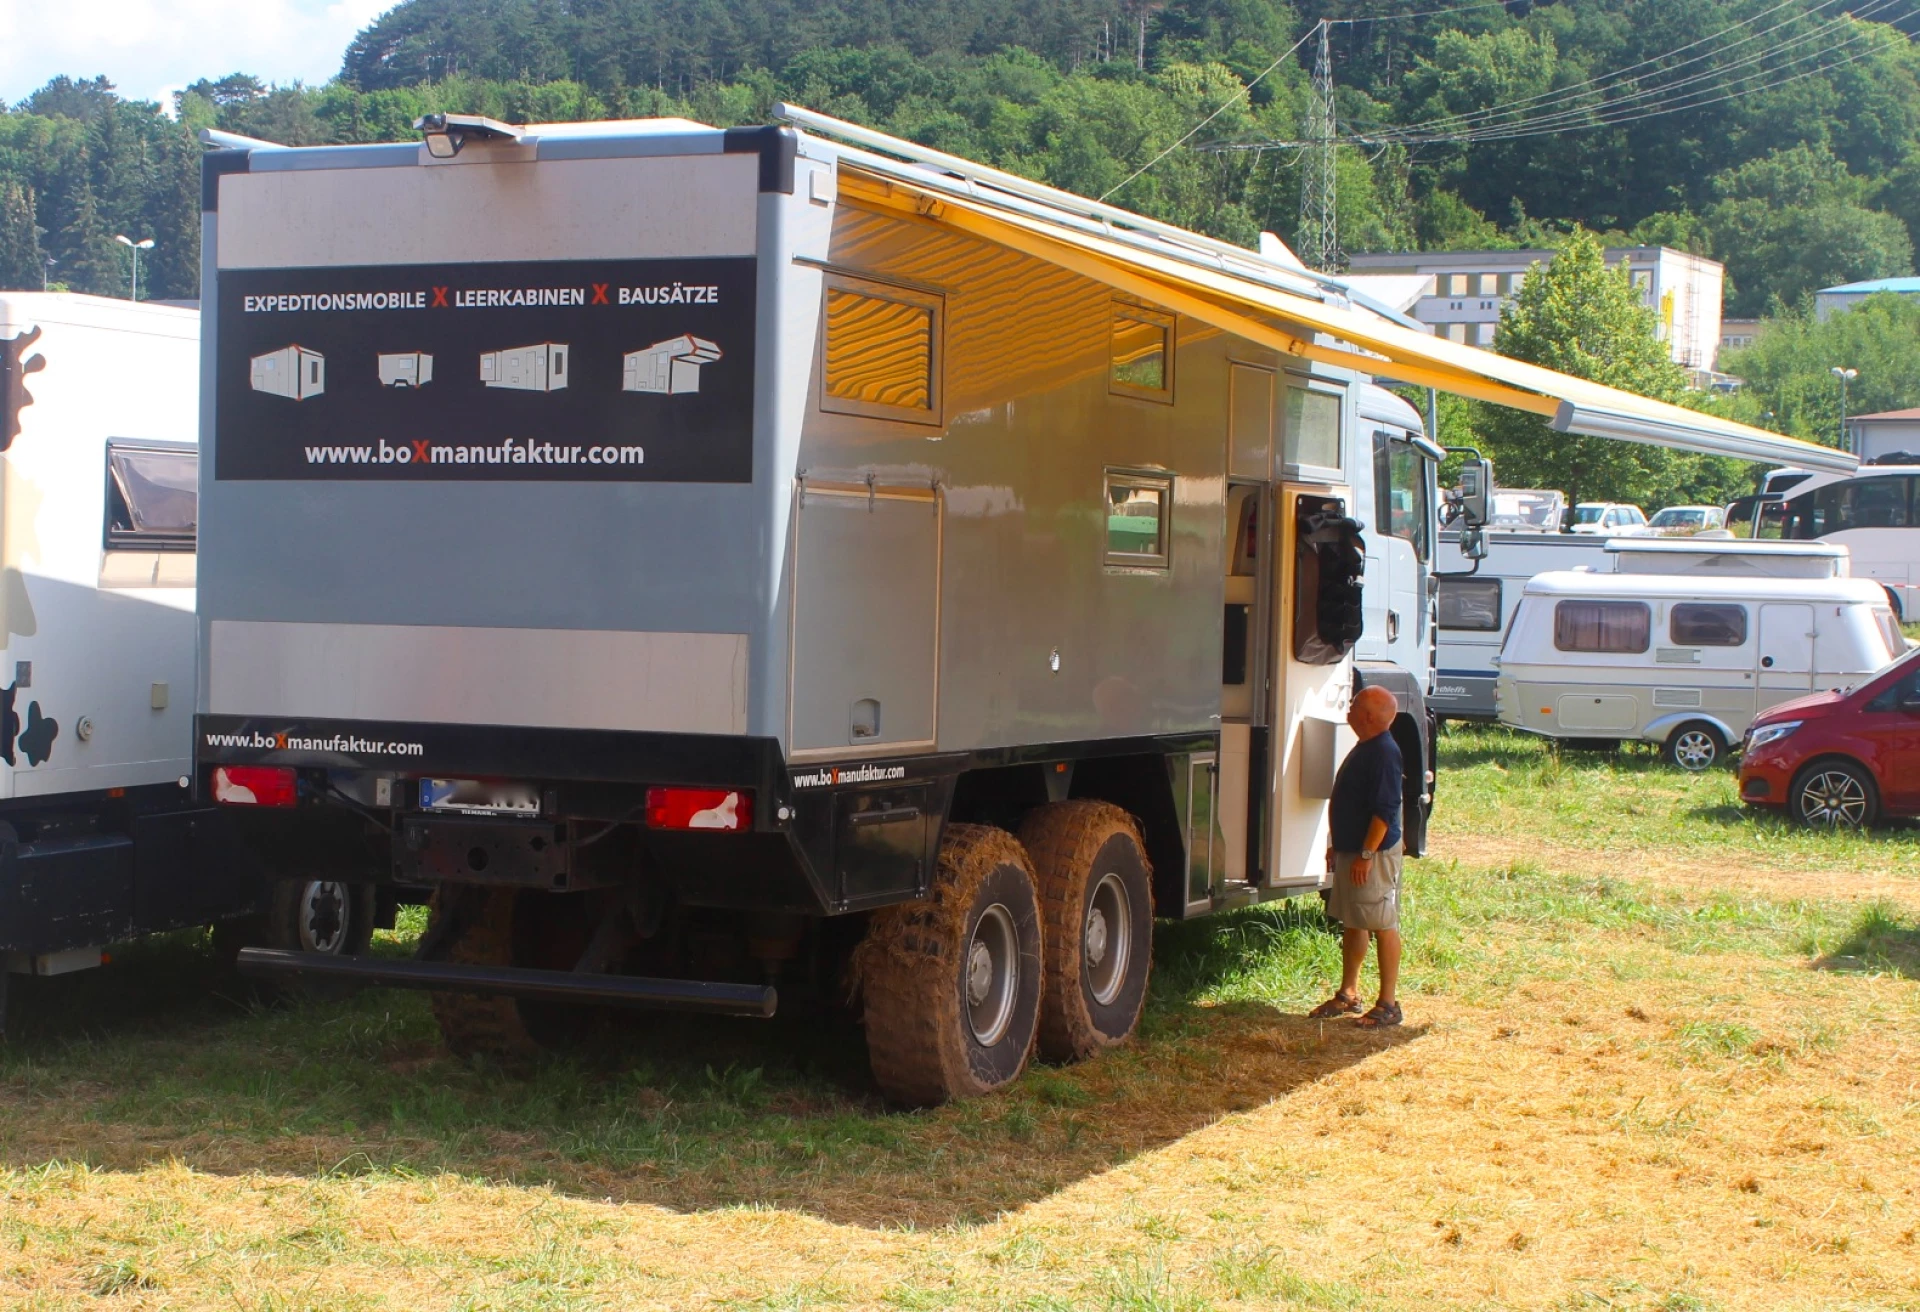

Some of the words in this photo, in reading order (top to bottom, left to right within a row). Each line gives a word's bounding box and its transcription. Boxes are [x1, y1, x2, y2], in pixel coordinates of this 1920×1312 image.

[243, 291, 426, 312] EXPEDTIONSMOBILE
[432, 286, 448, 308] X
[455, 288, 585, 308] LEERKABINEN
[592, 284, 609, 305] X
[618, 283, 719, 305] BAUSÄTZE
[305, 437, 645, 466] www.boXmanufaktur.com
[206, 731, 424, 756] www.boXmanufaktur.com
[794, 764, 905, 788] www.boXmanufaktur.com
